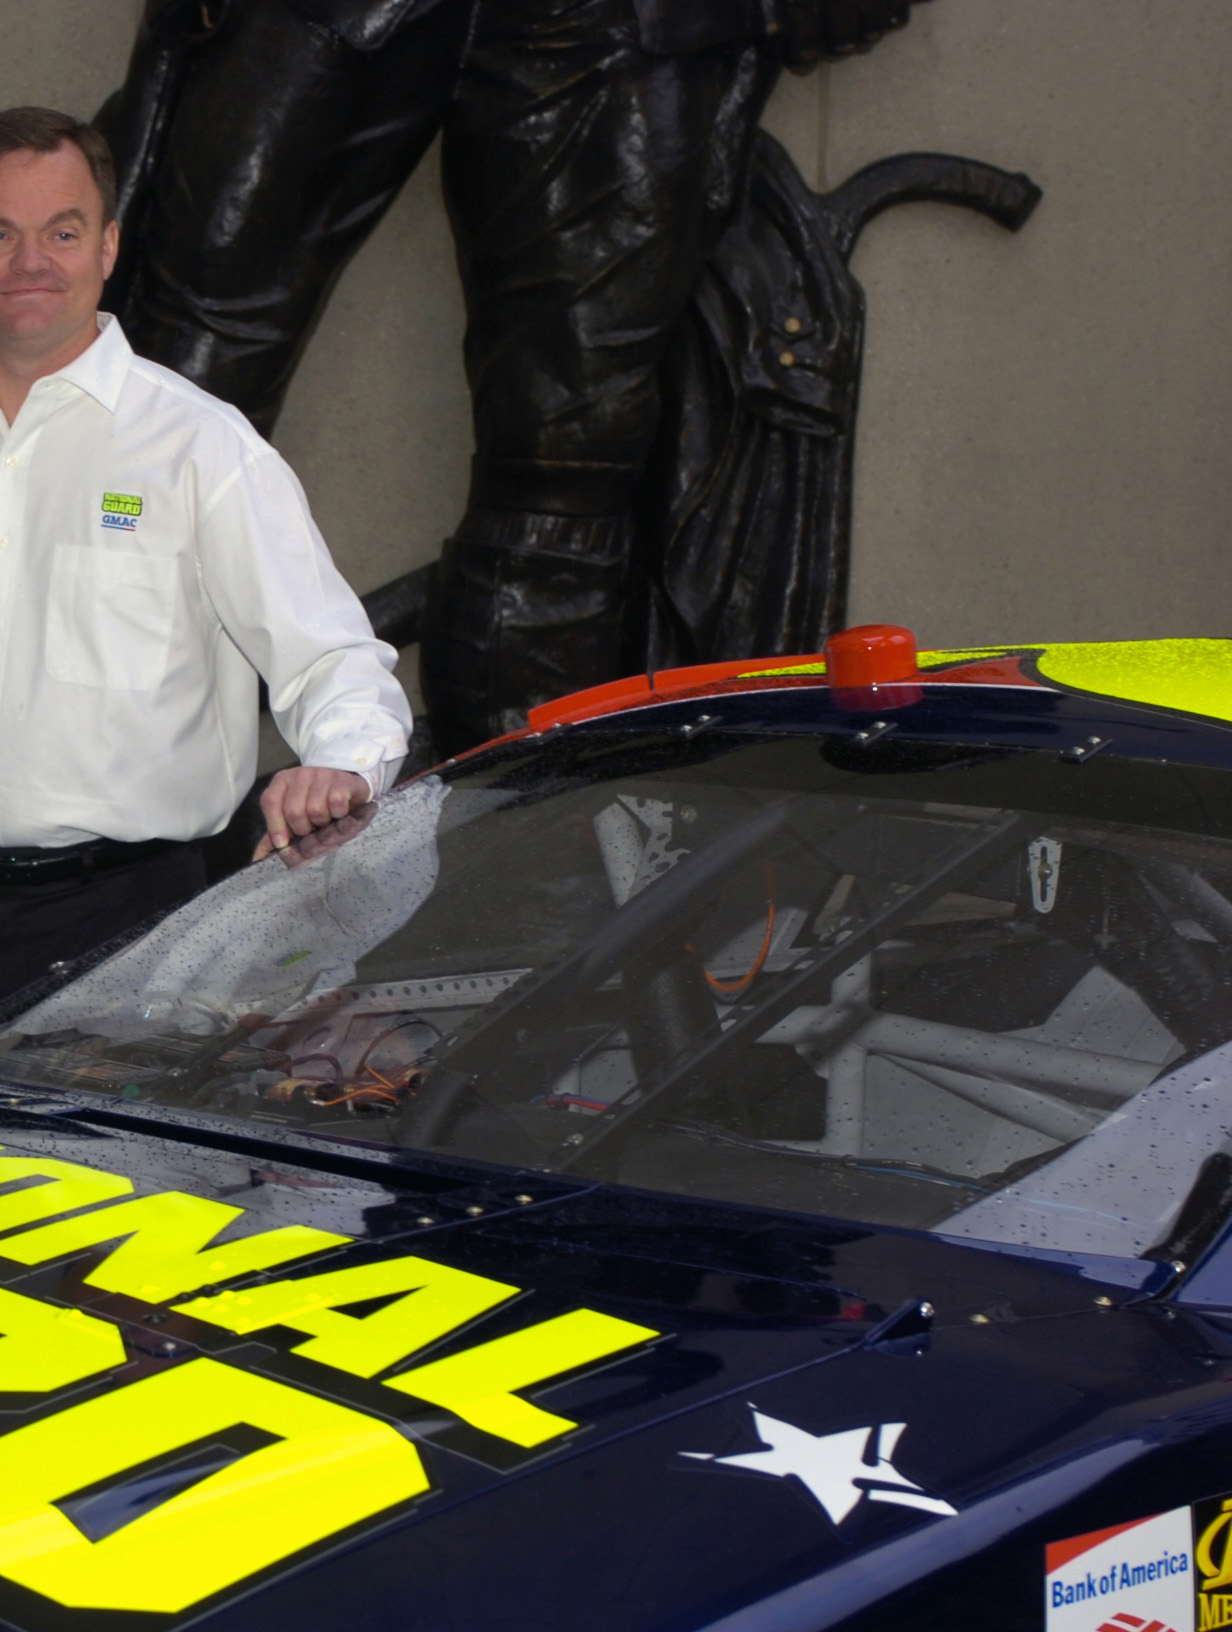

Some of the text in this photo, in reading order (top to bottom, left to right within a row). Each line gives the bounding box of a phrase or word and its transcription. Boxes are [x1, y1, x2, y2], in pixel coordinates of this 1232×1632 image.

[103, 500, 141, 515] GUARD
[103, 515, 137, 527] GMAC
[1052, 1550, 1188, 1608] Bank of America
